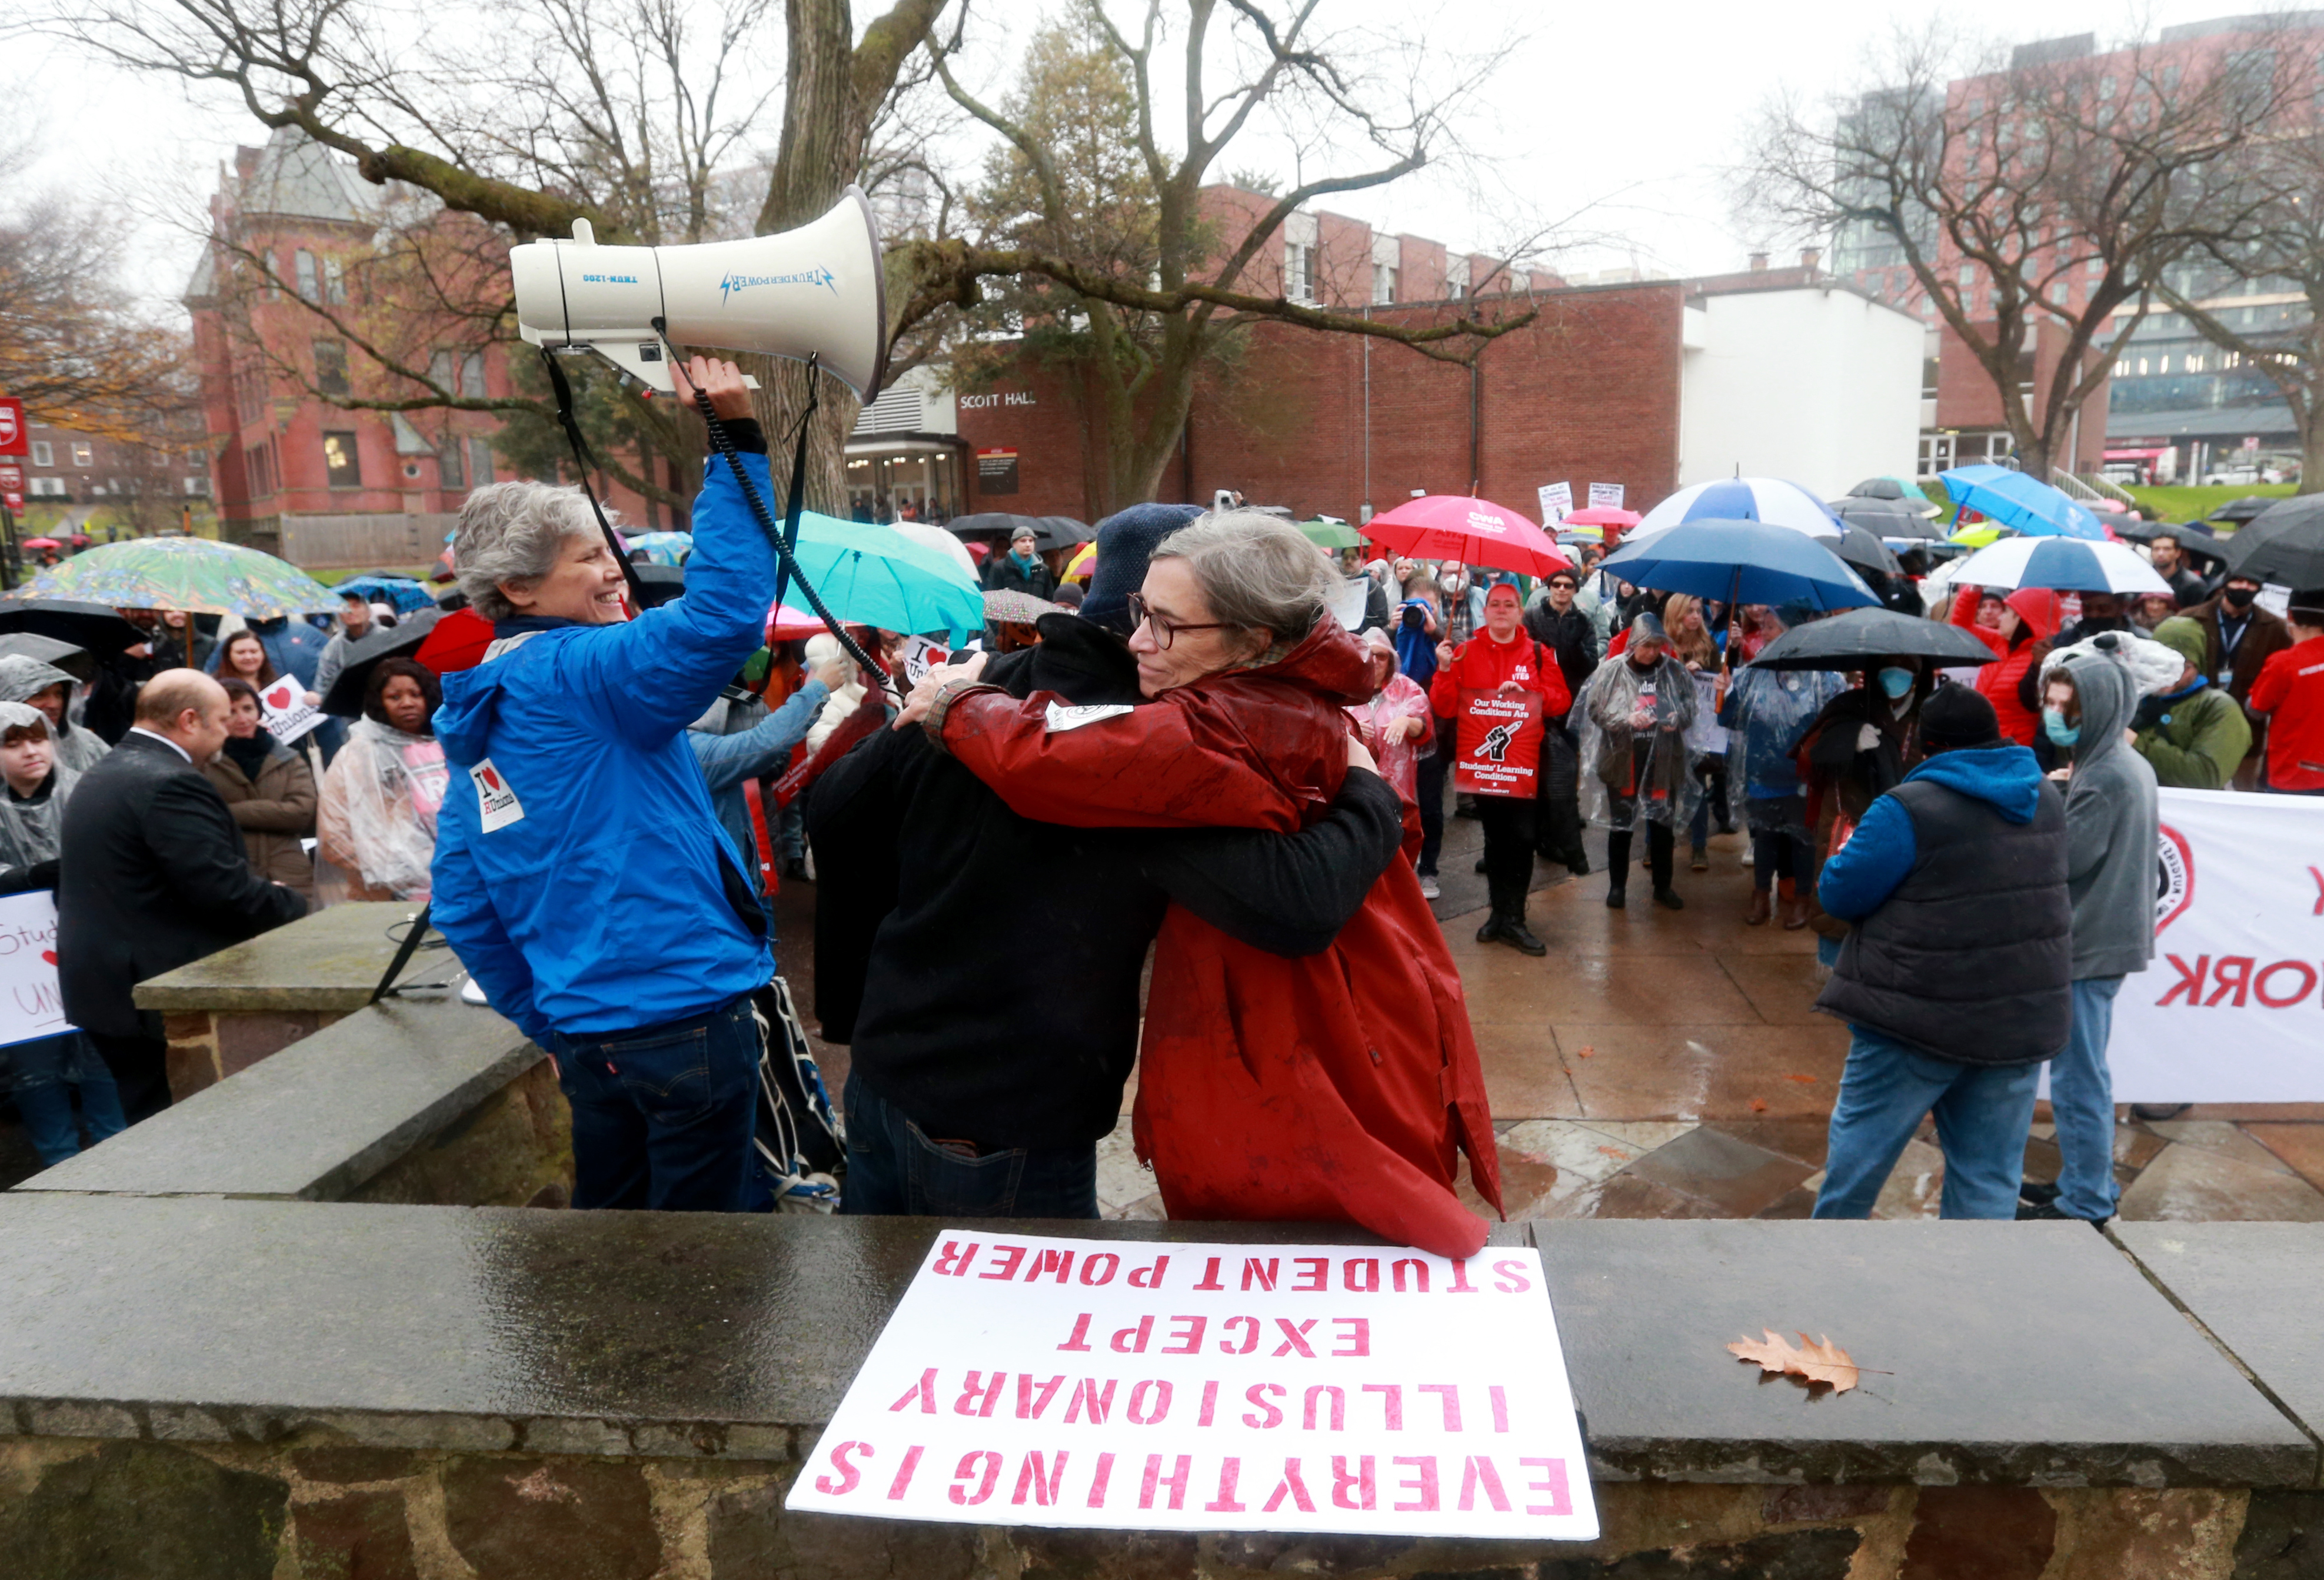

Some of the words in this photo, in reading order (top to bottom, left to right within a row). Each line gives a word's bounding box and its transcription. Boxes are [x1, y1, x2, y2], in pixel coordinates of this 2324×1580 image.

[583, 275, 638, 283] THUN-1200
[730, 270, 823, 291] THUNDERPOWER
[1469, 511, 1504, 525] CWA
[911, 641, 928, 663] I
[1470, 707, 1511, 717] Conditions
[1513, 710, 1529, 718] Are
[1474, 698, 1490, 707] Our
[1491, 700, 1526, 710] Working
[1459, 761, 1496, 771] Students'
[1497, 765, 1533, 776] Learning
[1474, 771, 1517, 781] Conditions
[420, 776, 446, 803] R
[474, 771, 491, 798] I
[933, 1241, 1171, 1289] POWER
[1193, 1257, 1531, 1293] STUDENT
[1057, 1313, 1370, 1358] EXCEPT
[889, 1368, 1509, 1433] ILLUSIONARY
[815, 1441, 925, 1500] IS
[948, 1451, 1573, 1515] EVERYTHING
